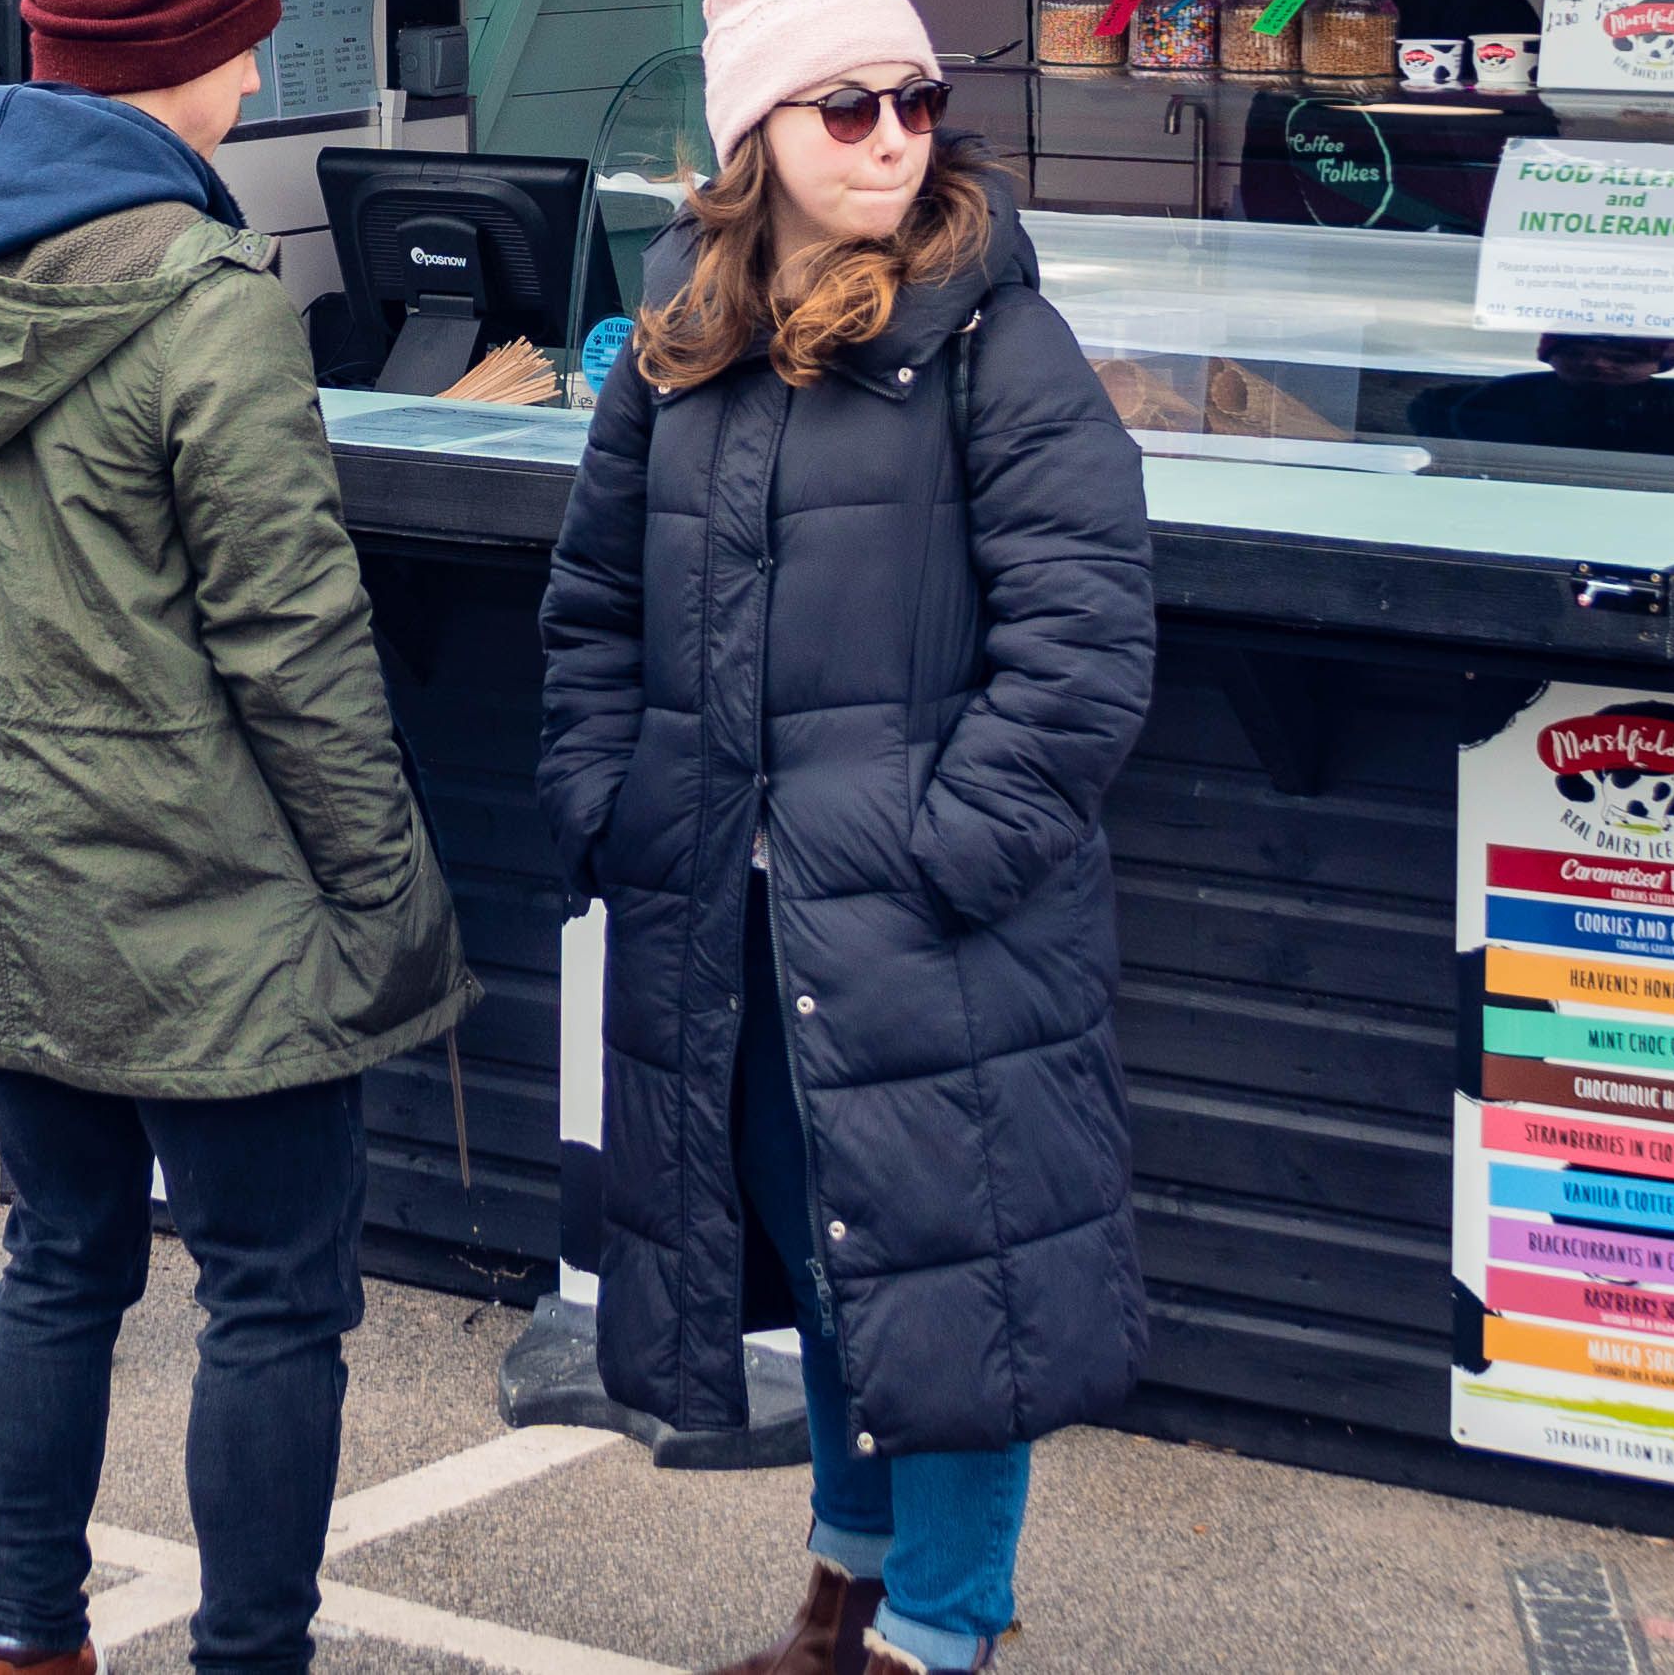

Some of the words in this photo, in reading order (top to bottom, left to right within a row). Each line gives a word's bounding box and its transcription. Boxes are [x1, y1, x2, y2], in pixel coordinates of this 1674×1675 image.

[1289, 133, 1345, 153] Coffee
[1315, 158, 1380, 183] Folkes
[1518, 162, 1593, 184] FOOD
[1605, 192, 1648, 208] and
[1560, 808, 1592, 841] REAL
[1597, 830, 1640, 857] DAIRY
[1649, 842, 1672, 859] ICE
[1560, 858, 1666, 889] Caramelised
[1575, 911, 1634, 937] COOKIES
[1636, 918, 1667, 941] AND
[1570, 969, 1638, 996] HEAVENLY
[1588, 1029, 1623, 1050] MINT
[1629, 1032, 1666, 1056] CHOC
[1574, 1076, 1660, 1109] CHOCOHOLIC
[1525, 1124, 1624, 1156] STRAWBERRIES
[1630, 1140, 1644, 1158] IN
[1563, 1181, 1620, 1208] VANILLA
[1528, 1231, 1643, 1267] BLACKCURRANTS
[1648, 1252, 1662, 1268] IN
[1583, 1288, 1659, 1316] RASPBERRY
[1587, 1339, 1641, 1369] MANGO
[1544, 1427, 1611, 1454] STRAIGHT
[1617, 1438, 1653, 1463] FROM
